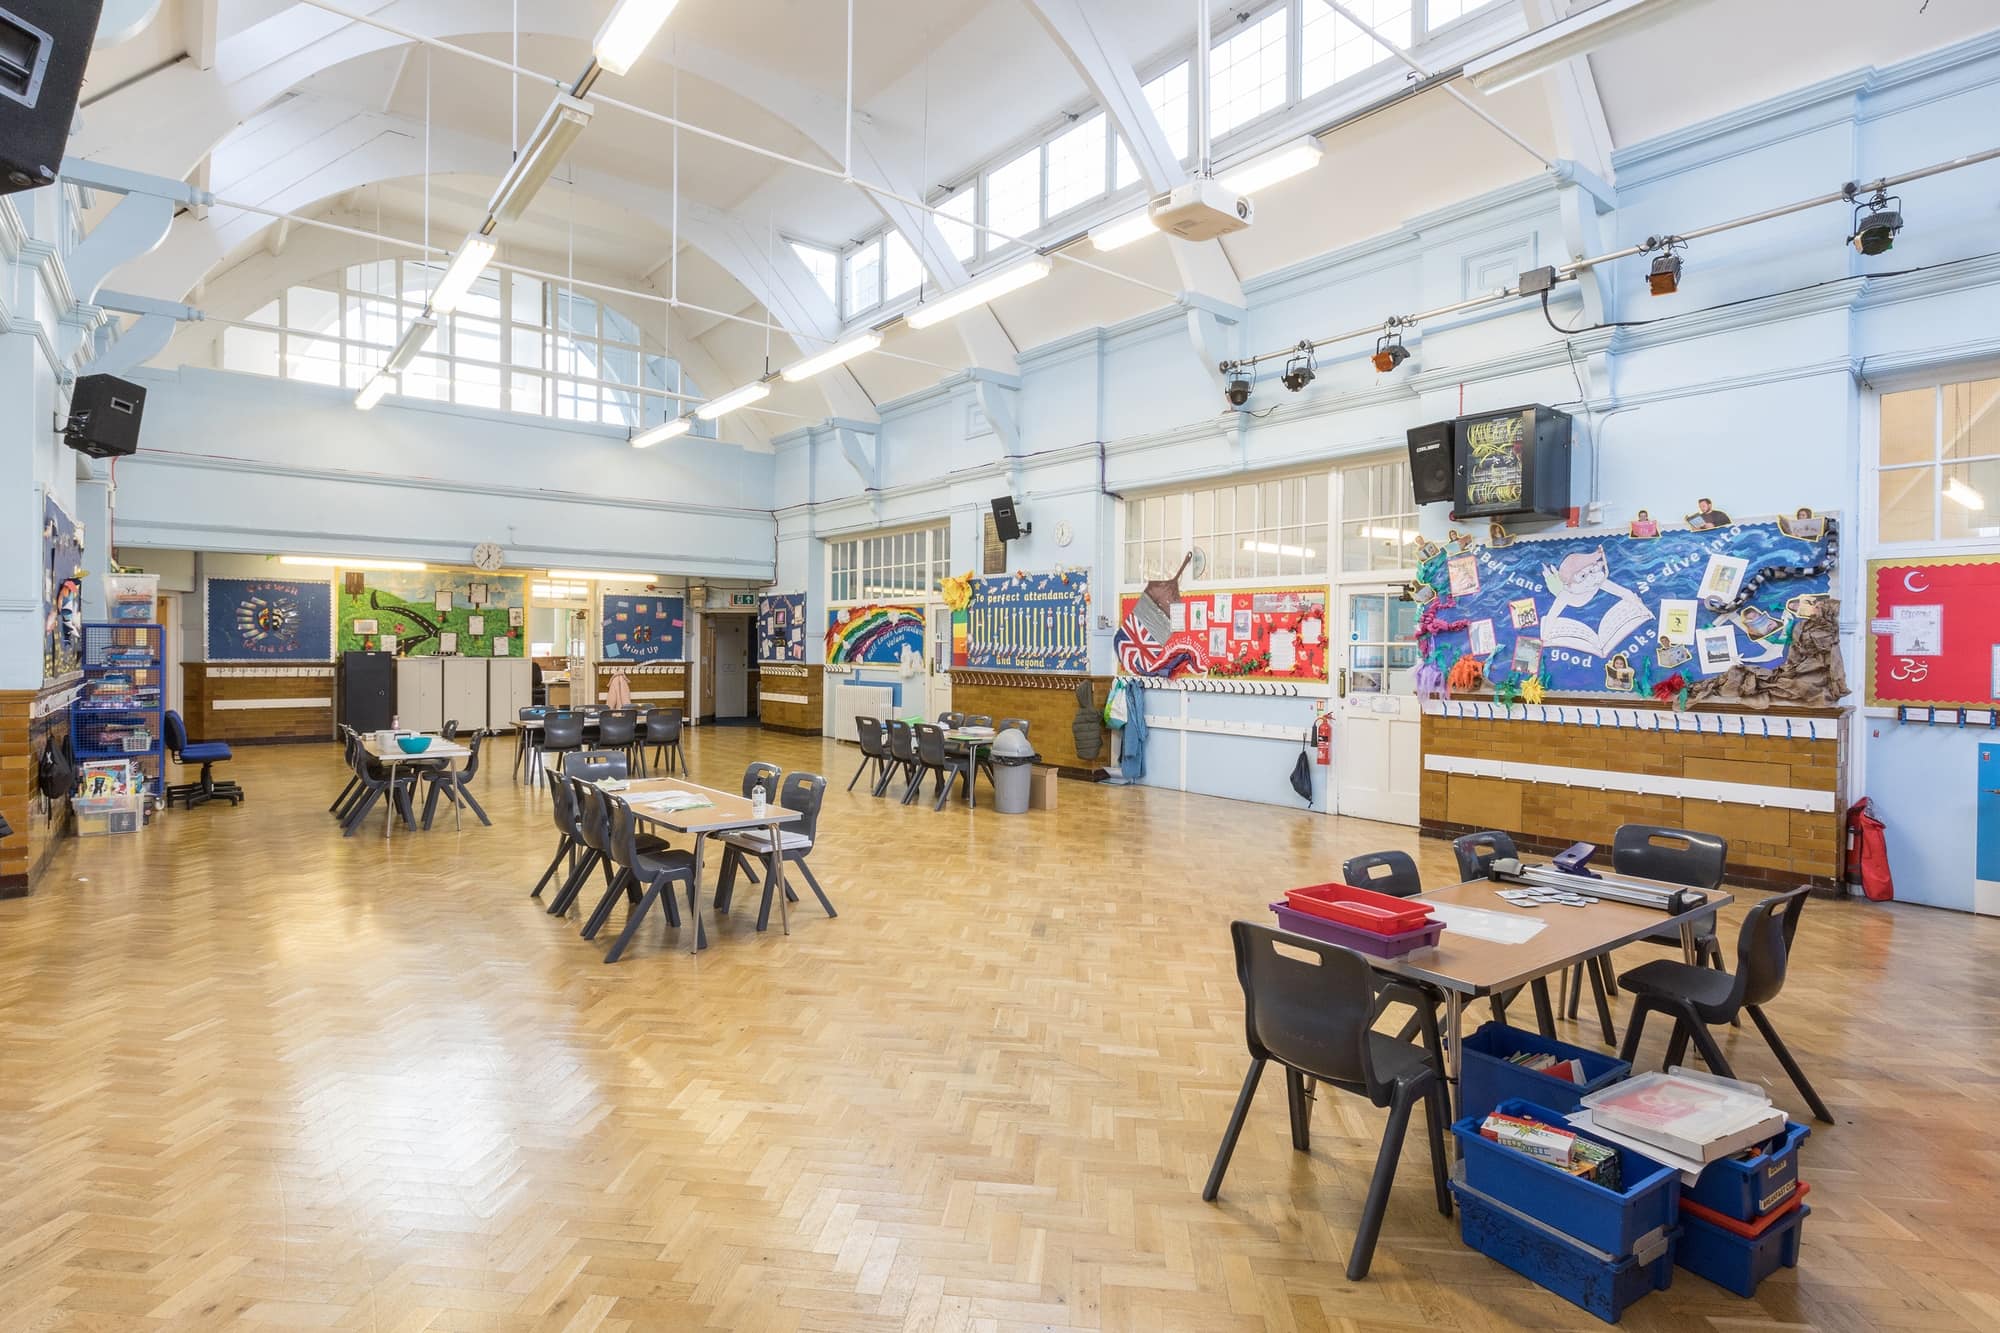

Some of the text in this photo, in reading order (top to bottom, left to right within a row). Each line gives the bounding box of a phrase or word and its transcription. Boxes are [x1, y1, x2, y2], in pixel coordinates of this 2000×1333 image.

[1480, 551, 1507, 576] Bell
[1507, 571, 1543, 592] Lane
[1636, 526, 1741, 594] we dive into
[976, 589, 1075, 606] To perfect attendance
[622, 643, 659, 656] Mind Up
[1551, 629, 1656, 668] good ooks
